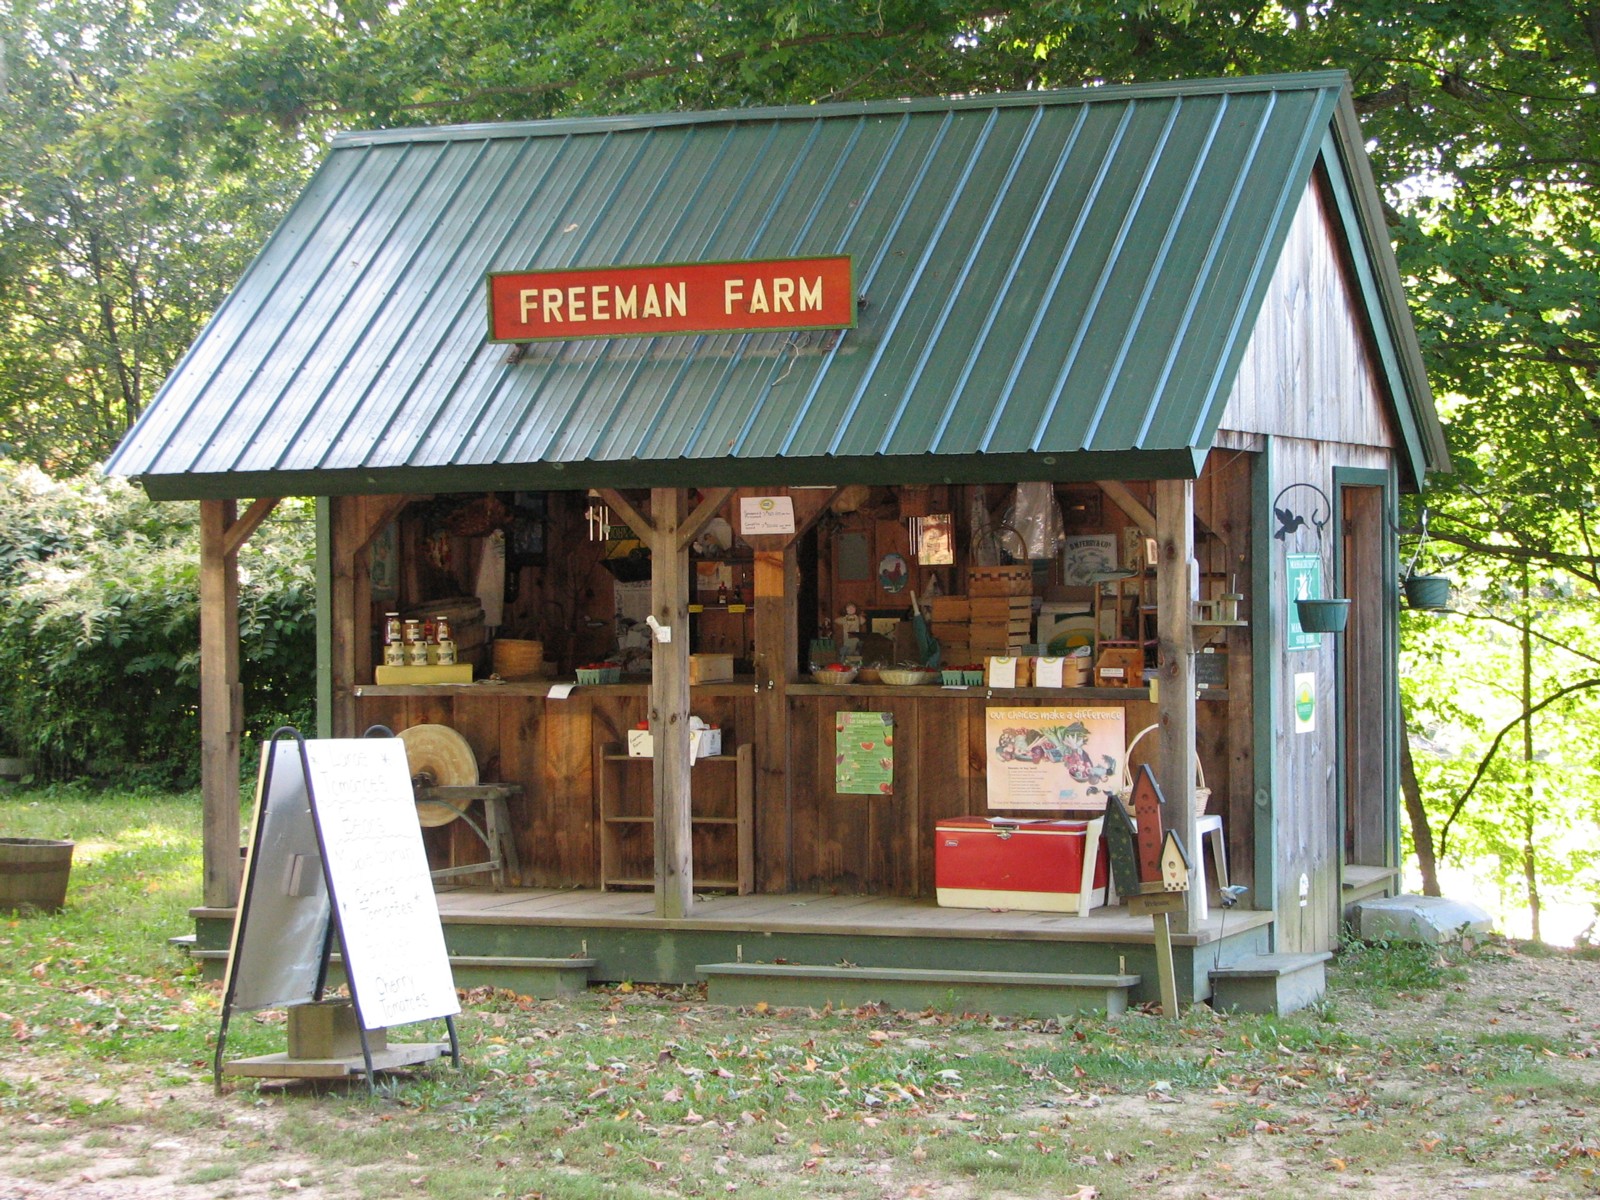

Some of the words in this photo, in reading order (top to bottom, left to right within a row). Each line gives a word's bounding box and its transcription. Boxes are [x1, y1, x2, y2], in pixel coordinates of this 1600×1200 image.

[520, 282, 687, 324] FREEMAN
[724, 276, 823, 315] FARM
[990, 711, 1004, 720] our
[1007, 710, 1039, 720] choices
[1040, 709, 1065, 720] make
[1066, 712, 1073, 720] a
[1074, 709, 1122, 721] difference
[375, 975, 415, 997] Cherry
[378, 992, 430, 1020] Tomatoes
